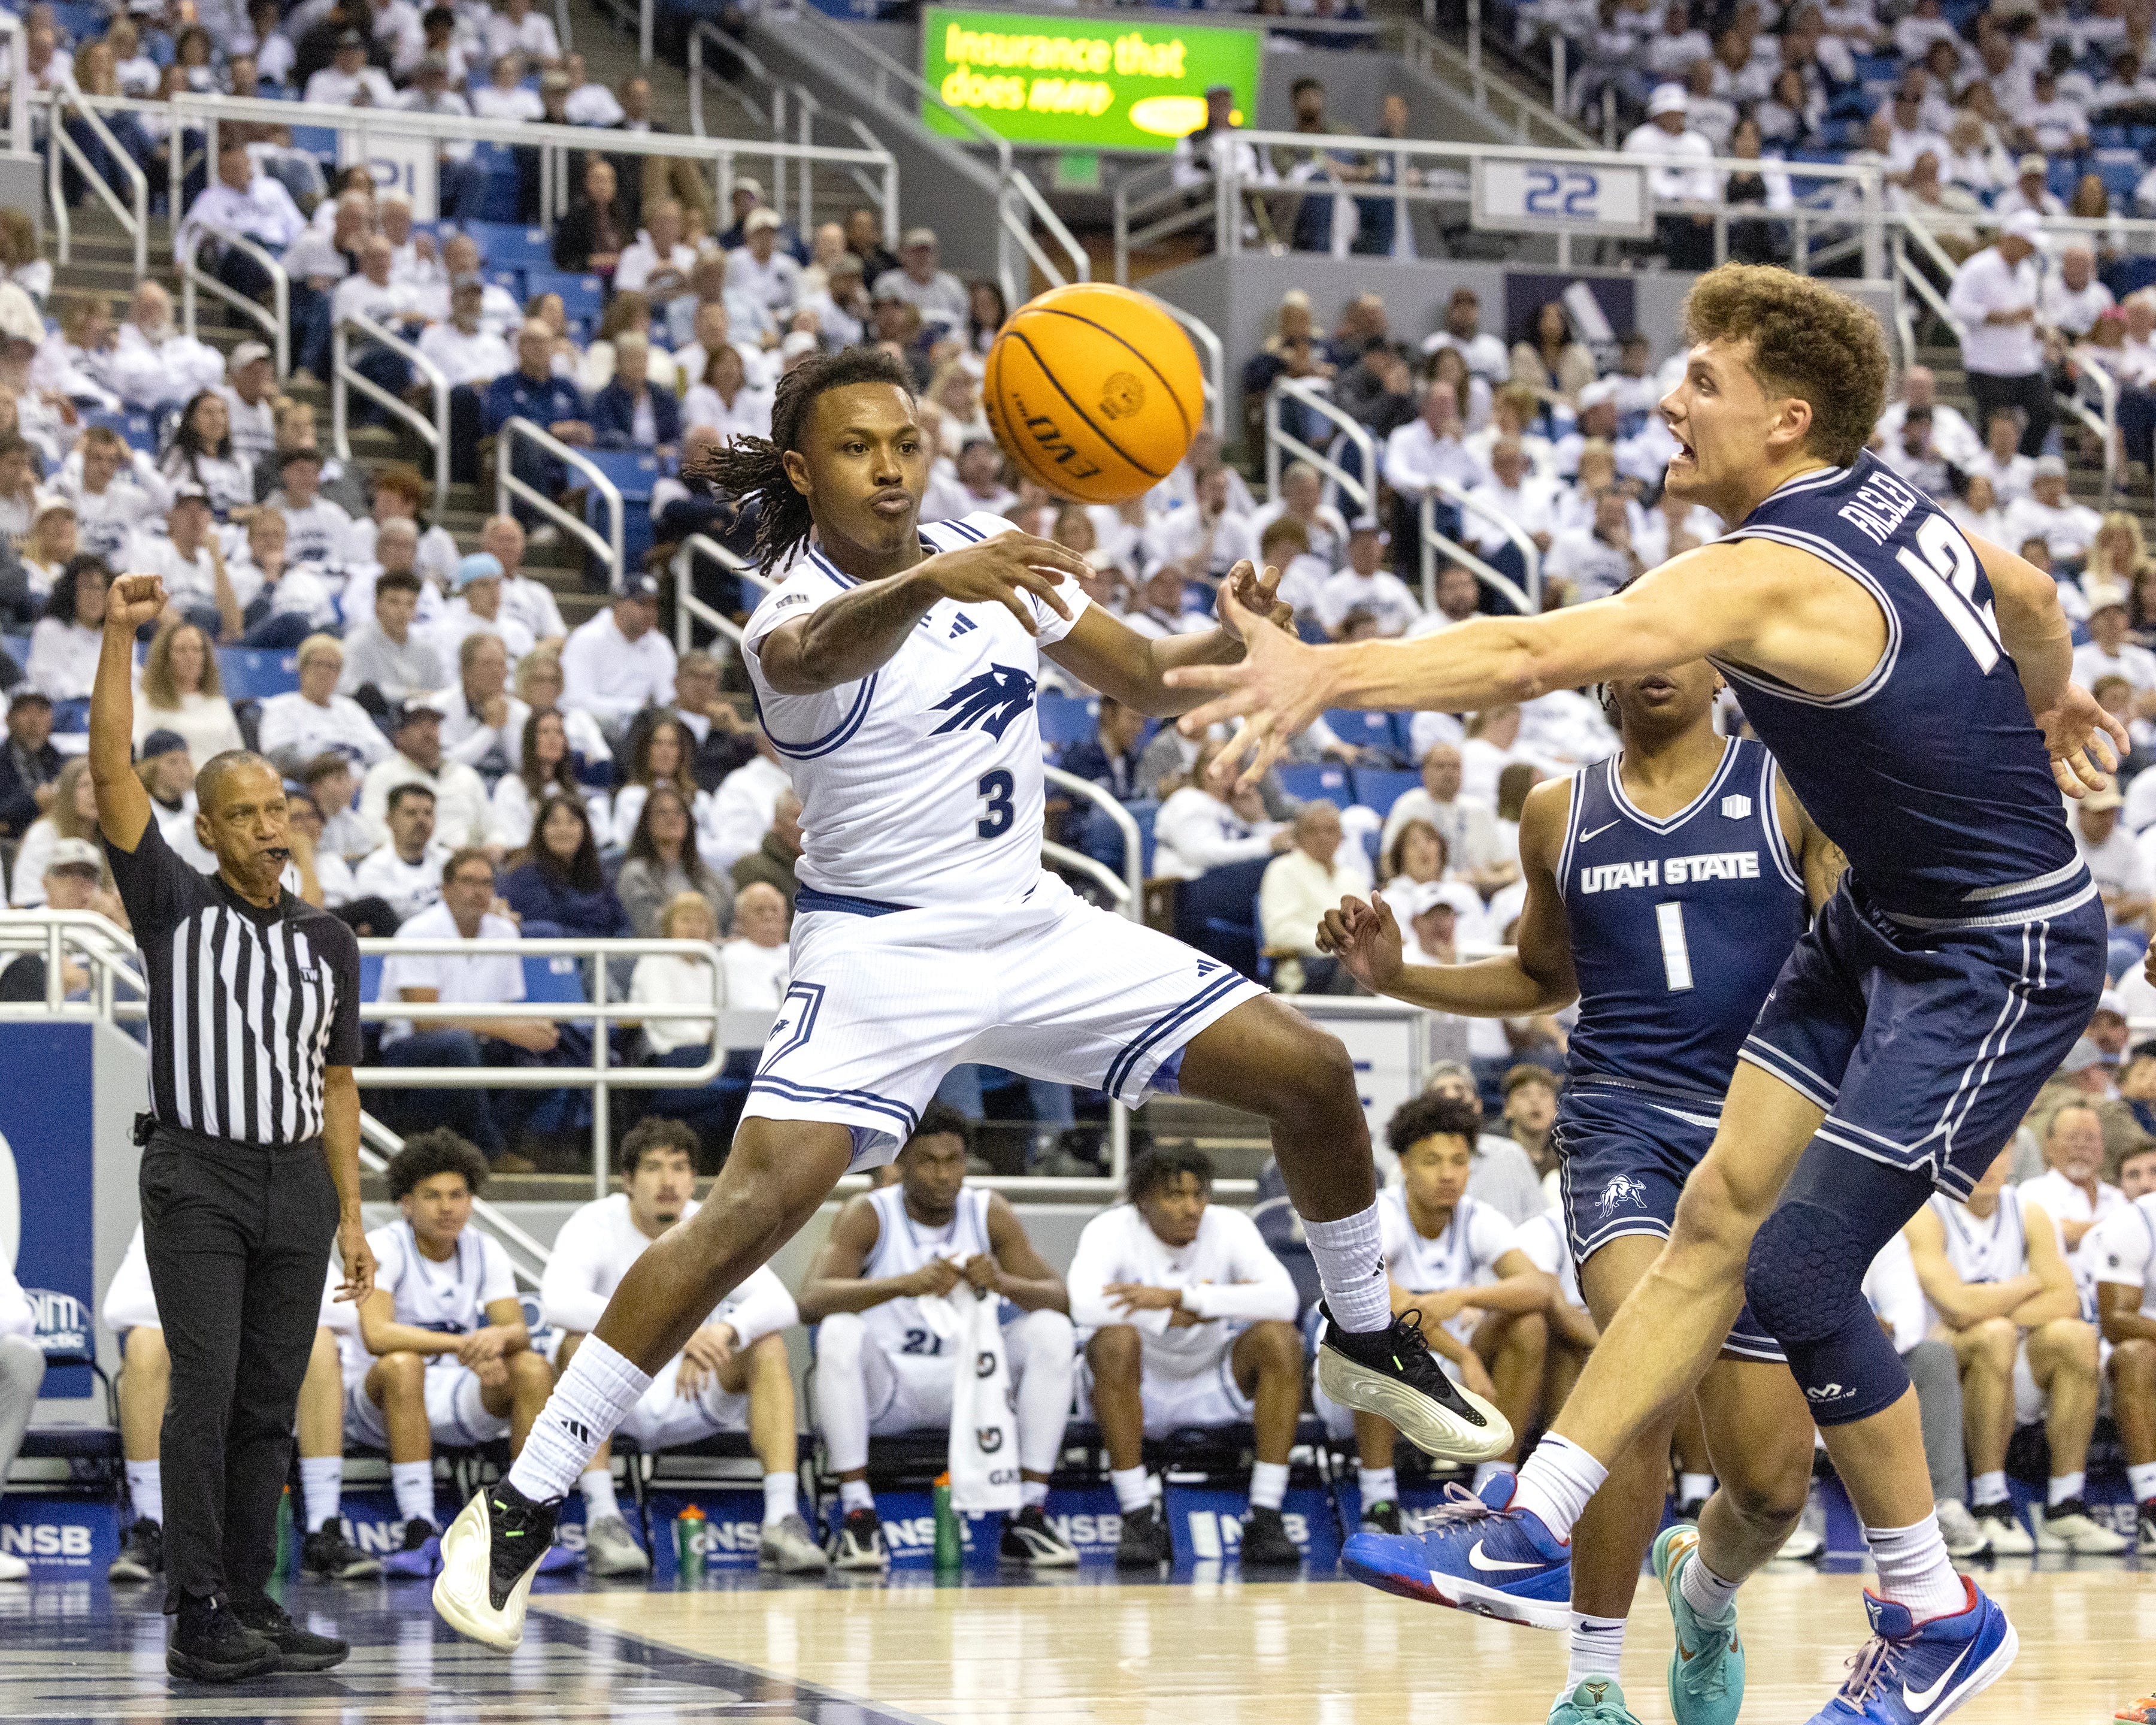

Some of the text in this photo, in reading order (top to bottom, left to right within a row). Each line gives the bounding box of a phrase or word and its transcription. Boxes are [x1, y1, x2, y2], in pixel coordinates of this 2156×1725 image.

[946, 23, 1186, 78] Insurance that
[942, 64, 1026, 110] does
[1526, 169, 1598, 216] 22
[1895, 513, 2009, 676] 12
[976, 767, 1016, 842] 3
[1580, 851, 1761, 894] UTAH STATE
[1655, 901, 1694, 992] 1
[1, 1523, 92, 1555] NSB
[705, 1521, 763, 1551] NS
